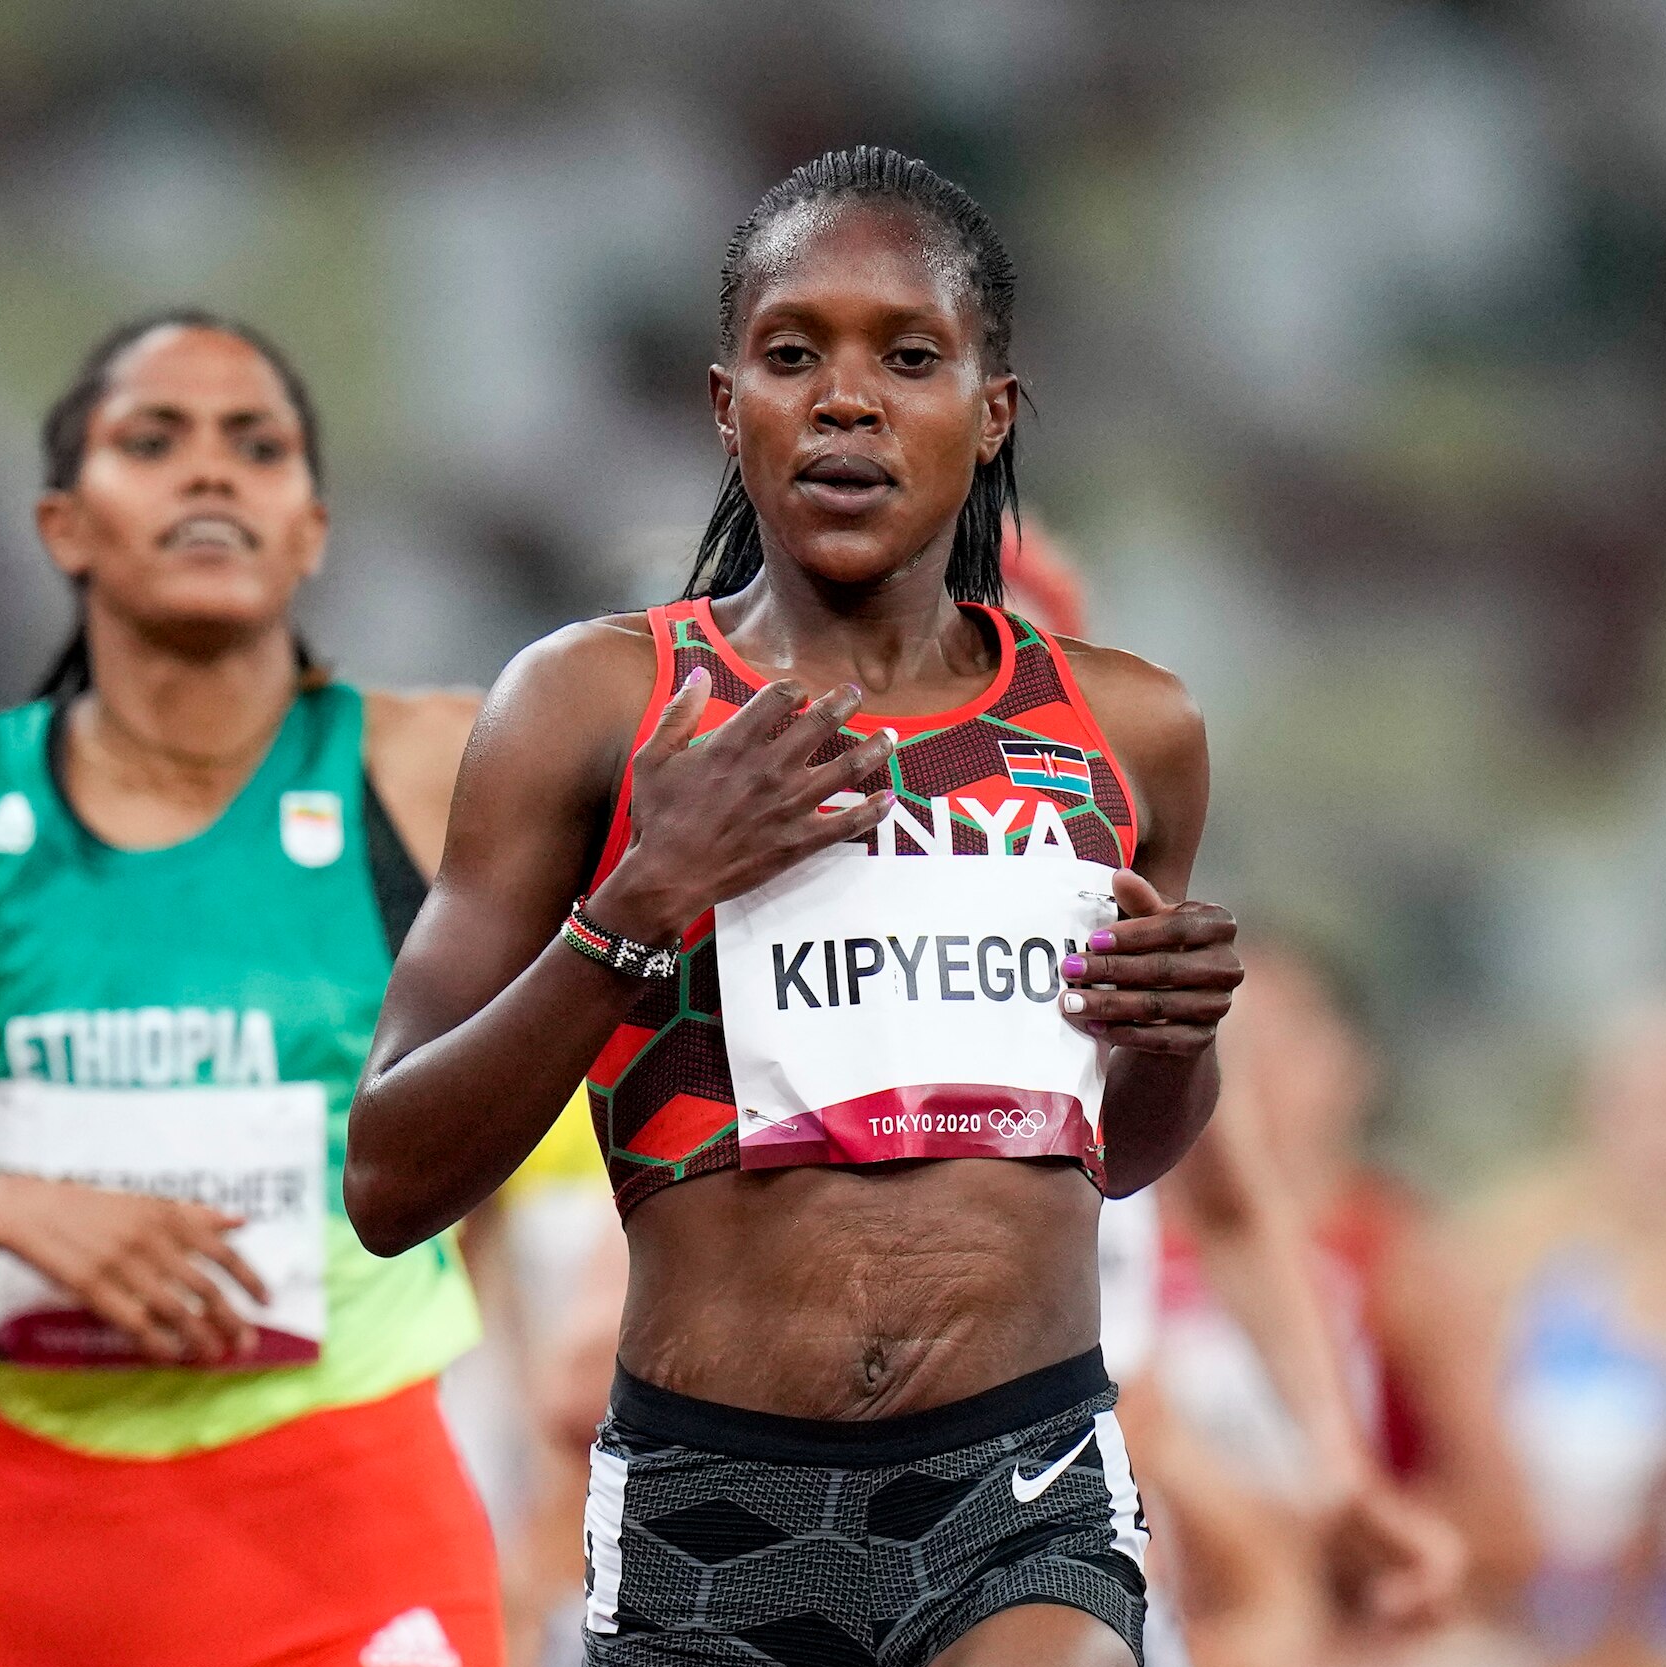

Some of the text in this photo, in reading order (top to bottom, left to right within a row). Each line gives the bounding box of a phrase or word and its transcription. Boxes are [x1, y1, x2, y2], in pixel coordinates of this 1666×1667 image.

[815, 791, 1077, 858] NYA
[4, 1006, 279, 1086] ETHIOPIA
[868, 1113, 981, 1137] TOKYO 2020
